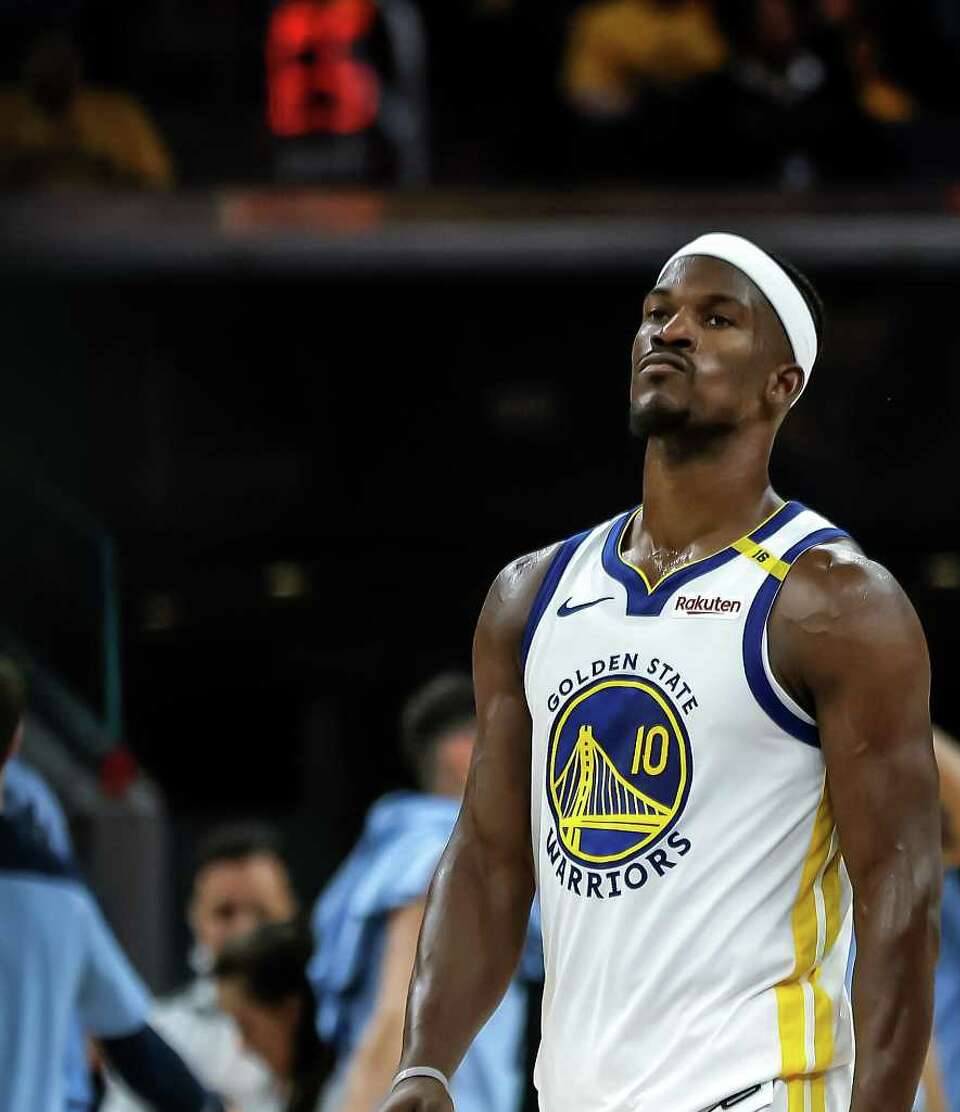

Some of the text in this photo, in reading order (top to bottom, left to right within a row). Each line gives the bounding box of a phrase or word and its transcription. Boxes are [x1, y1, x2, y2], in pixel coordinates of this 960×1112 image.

[675, 597, 741, 614] Rakuten
[547, 653, 699, 716] GOLDEN STATE
[632, 725, 670, 776] 10
[545, 828, 691, 899] WARRIORS
